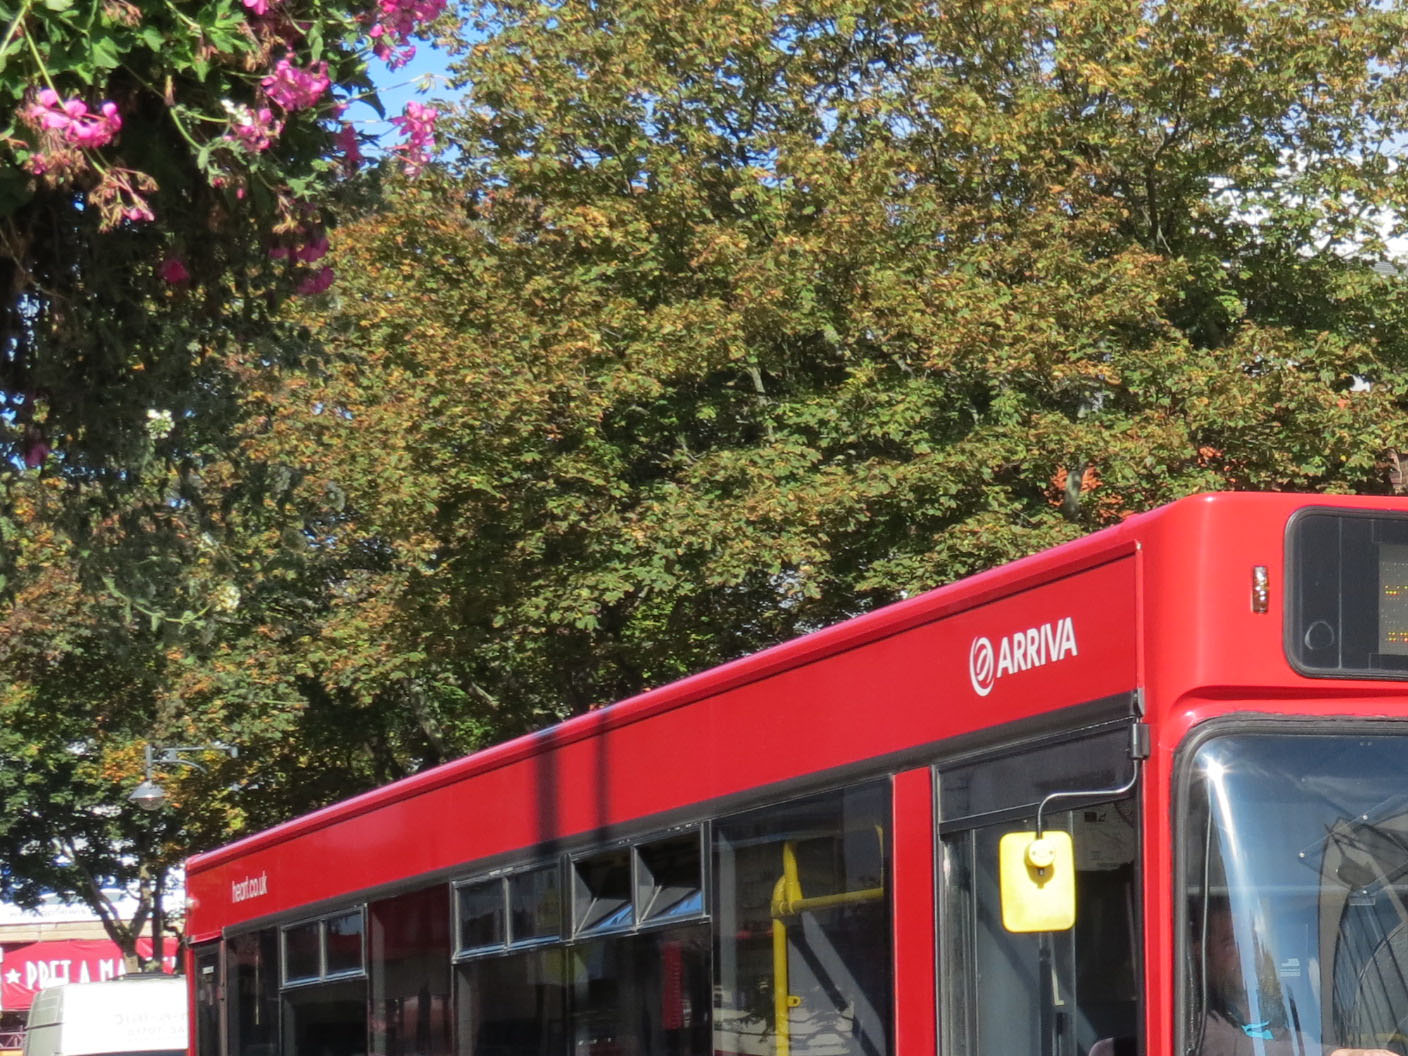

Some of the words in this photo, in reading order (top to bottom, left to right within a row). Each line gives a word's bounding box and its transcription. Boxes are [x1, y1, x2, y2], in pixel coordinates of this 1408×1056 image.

[996, 617, 1078, 678] ARRIVA
[232, 870, 267, 904] heart.co.uk
[26, 960, 72, 990] PRET
[79, 960, 91, 984] A
